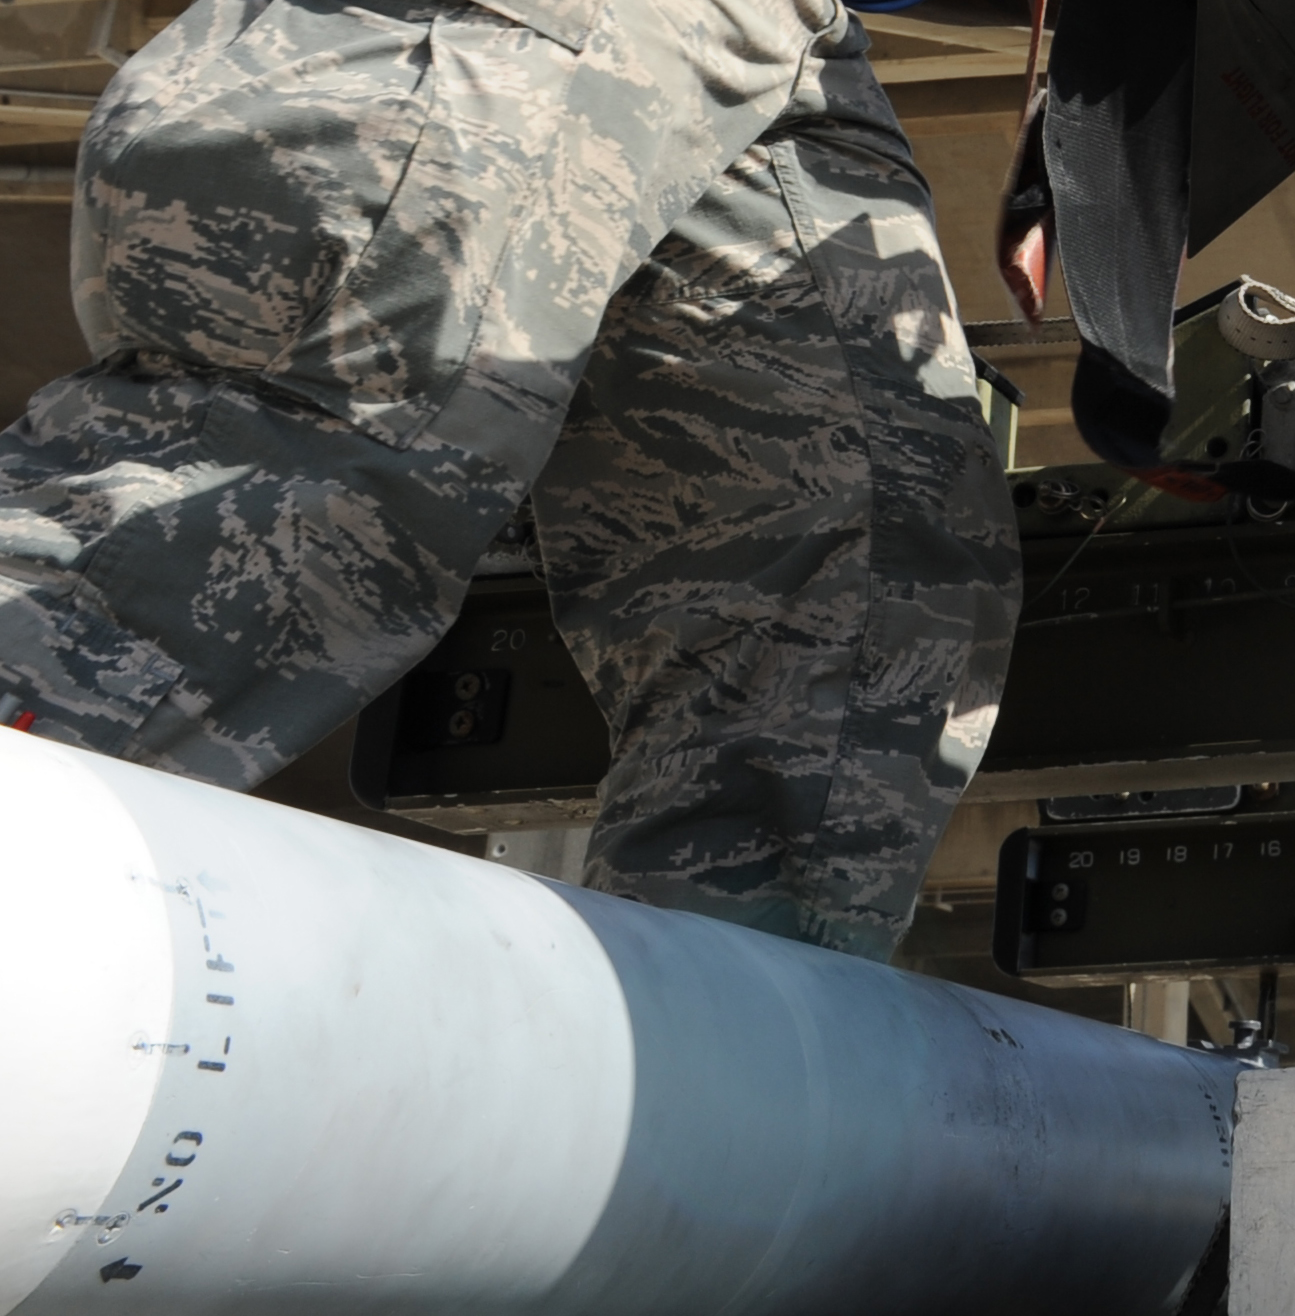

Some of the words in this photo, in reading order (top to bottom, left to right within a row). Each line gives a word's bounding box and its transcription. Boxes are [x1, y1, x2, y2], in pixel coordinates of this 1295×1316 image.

[1219, 67, 1270, 120] FLIGHT
[1257, 108, 1289, 144] FOR
[489, 629, 526, 653] 20
[1060, 586, 1091, 611] 12
[1068, 851, 1094, 868] 20
[1118, 848, 1141, 866] 19
[1165, 846, 1188, 863] 18
[1212, 842, 1234, 860] 17
[1259, 840, 1282, 858] 16
